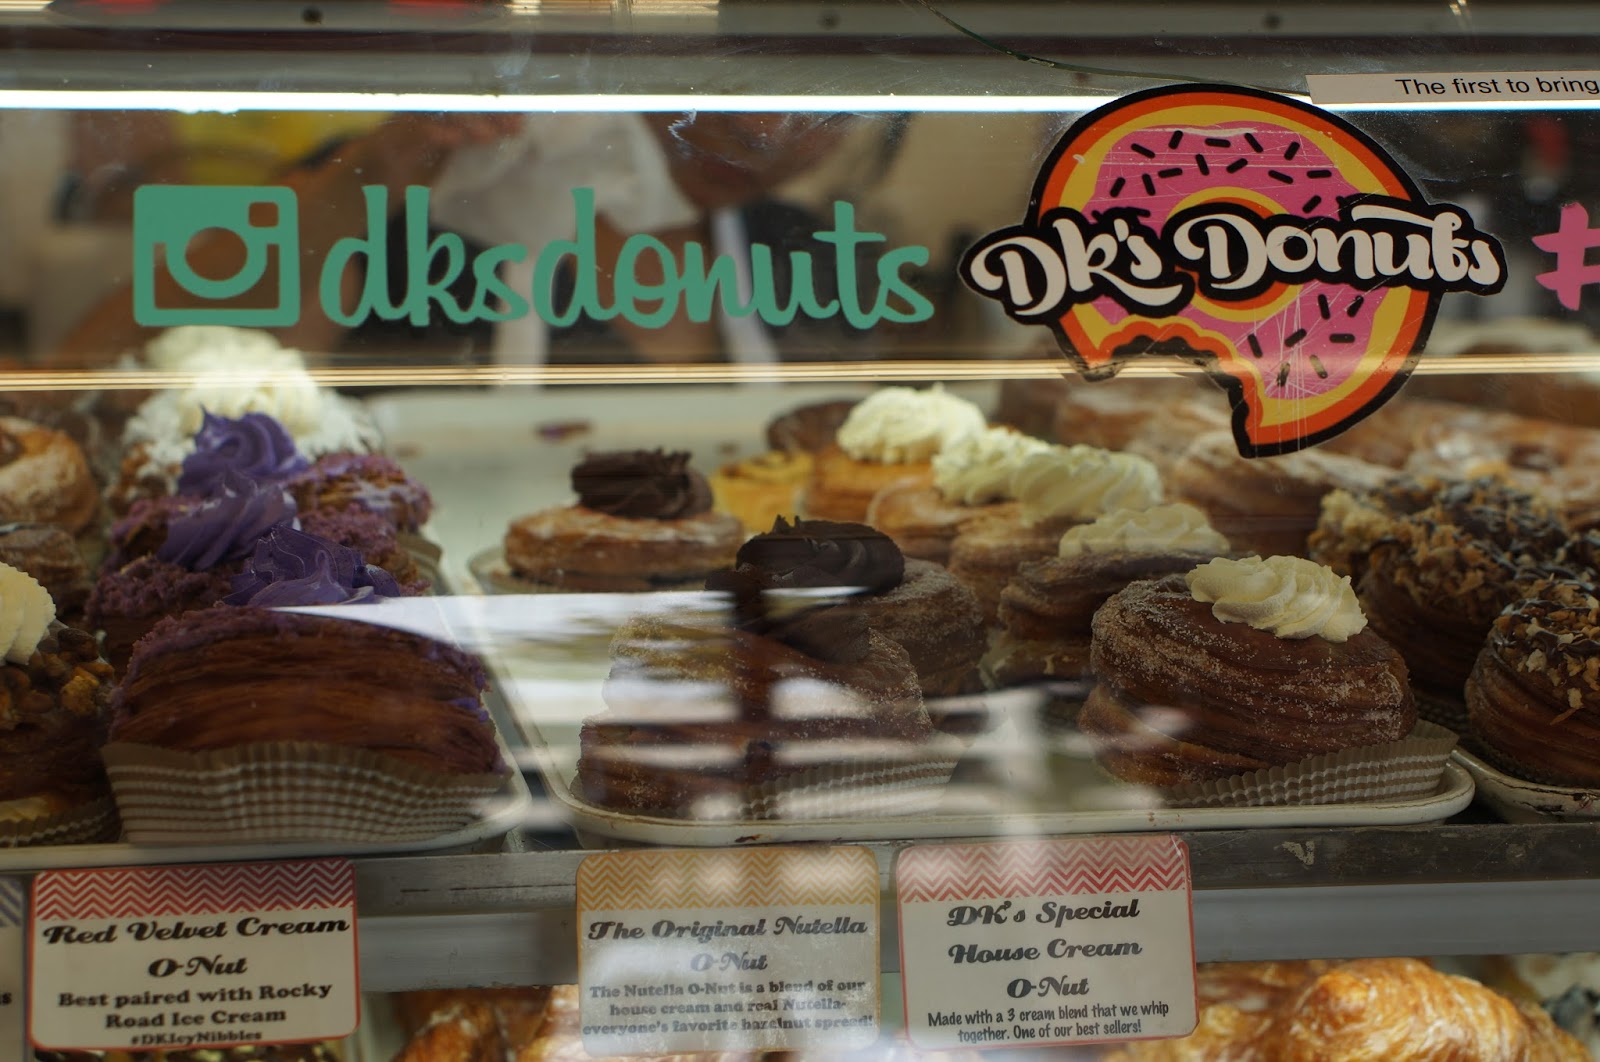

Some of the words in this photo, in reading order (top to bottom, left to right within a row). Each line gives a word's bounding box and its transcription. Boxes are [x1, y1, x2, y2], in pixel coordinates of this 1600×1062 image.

[1395, 79, 1446, 95] The
[1451, 78, 1502, 95] first
[1505, 78, 1530, 94] to
[1535, 77, 1600, 95] bring
[319, 184, 936, 330] dksdonuts
[1172, 203, 1500, 291] Donuts
[946, 900, 1026, 926] DK's
[1035, 899, 1140, 928] Special
[43, 925, 118, 944] Red
[127, 921, 228, 940] Velvet
[236, 917, 350, 938] Cream
[588, 921, 645, 940] The
[651, 919, 767, 943] Original
[773, 915, 869, 935] Nutella
[690, 952, 768, 972] O-Nut
[947, 944, 1040, 963] House
[1047, 938, 1143, 958] Cream
[147, 955, 249, 977] O-Nut
[59, 992, 109, 1007] Best
[114, 989, 190, 1010] paired
[197, 988, 253, 1003] with
[258, 983, 333, 1002] Rocky
[590, 986, 620, 998] The
[624, 984, 684, 997] Nutella
[688, 982, 735, 995] O-Nut
[740, 982, 753, 993] is
[756, 984, 765, 993] a
[769, 980, 813, 992] blend
[817, 980, 834, 991] of
[837, 981, 866, 991] our
[1006, 975, 1090, 998] O-Nut
[105, 1013, 166, 1029] Road
[171, 1012, 206, 1026] Ice
[211, 1008, 287, 1025] Cream
[609, 1004, 657, 1016] house
[660, 1004, 710, 1014] cream
[714, 1002, 744, 1012] and
[747, 1000, 778, 1012] real
[928, 1012, 963, 1027] Made
[965, 1010, 993, 1024] with
[996, 1014, 1004, 1023] a
[1008, 1008, 1016, 1022] 3
[1019, 1010, 1055, 1022] cream
[1058, 1004, 1088, 1019] blend
[1092, 1003, 1118, 1017] that
[1120, 1006, 1139, 1016] we
[1141, 1001, 1169, 1018] whip
[582, 1020, 669, 1036] everyone's
[672, 1018, 738, 1033] favorite
[741, 1017, 811, 1030] hazelnut
[815, 1015, 873, 1030] spread!
[957, 1029, 1010, 1043] together.
[1013, 1025, 1036, 1039] One
[1038, 1023, 1051, 1037] of
[1054, 1025, 1072, 1037] our
[1076, 1021, 1100, 1035] best
[1103, 1019, 1142, 1034] sellers!
